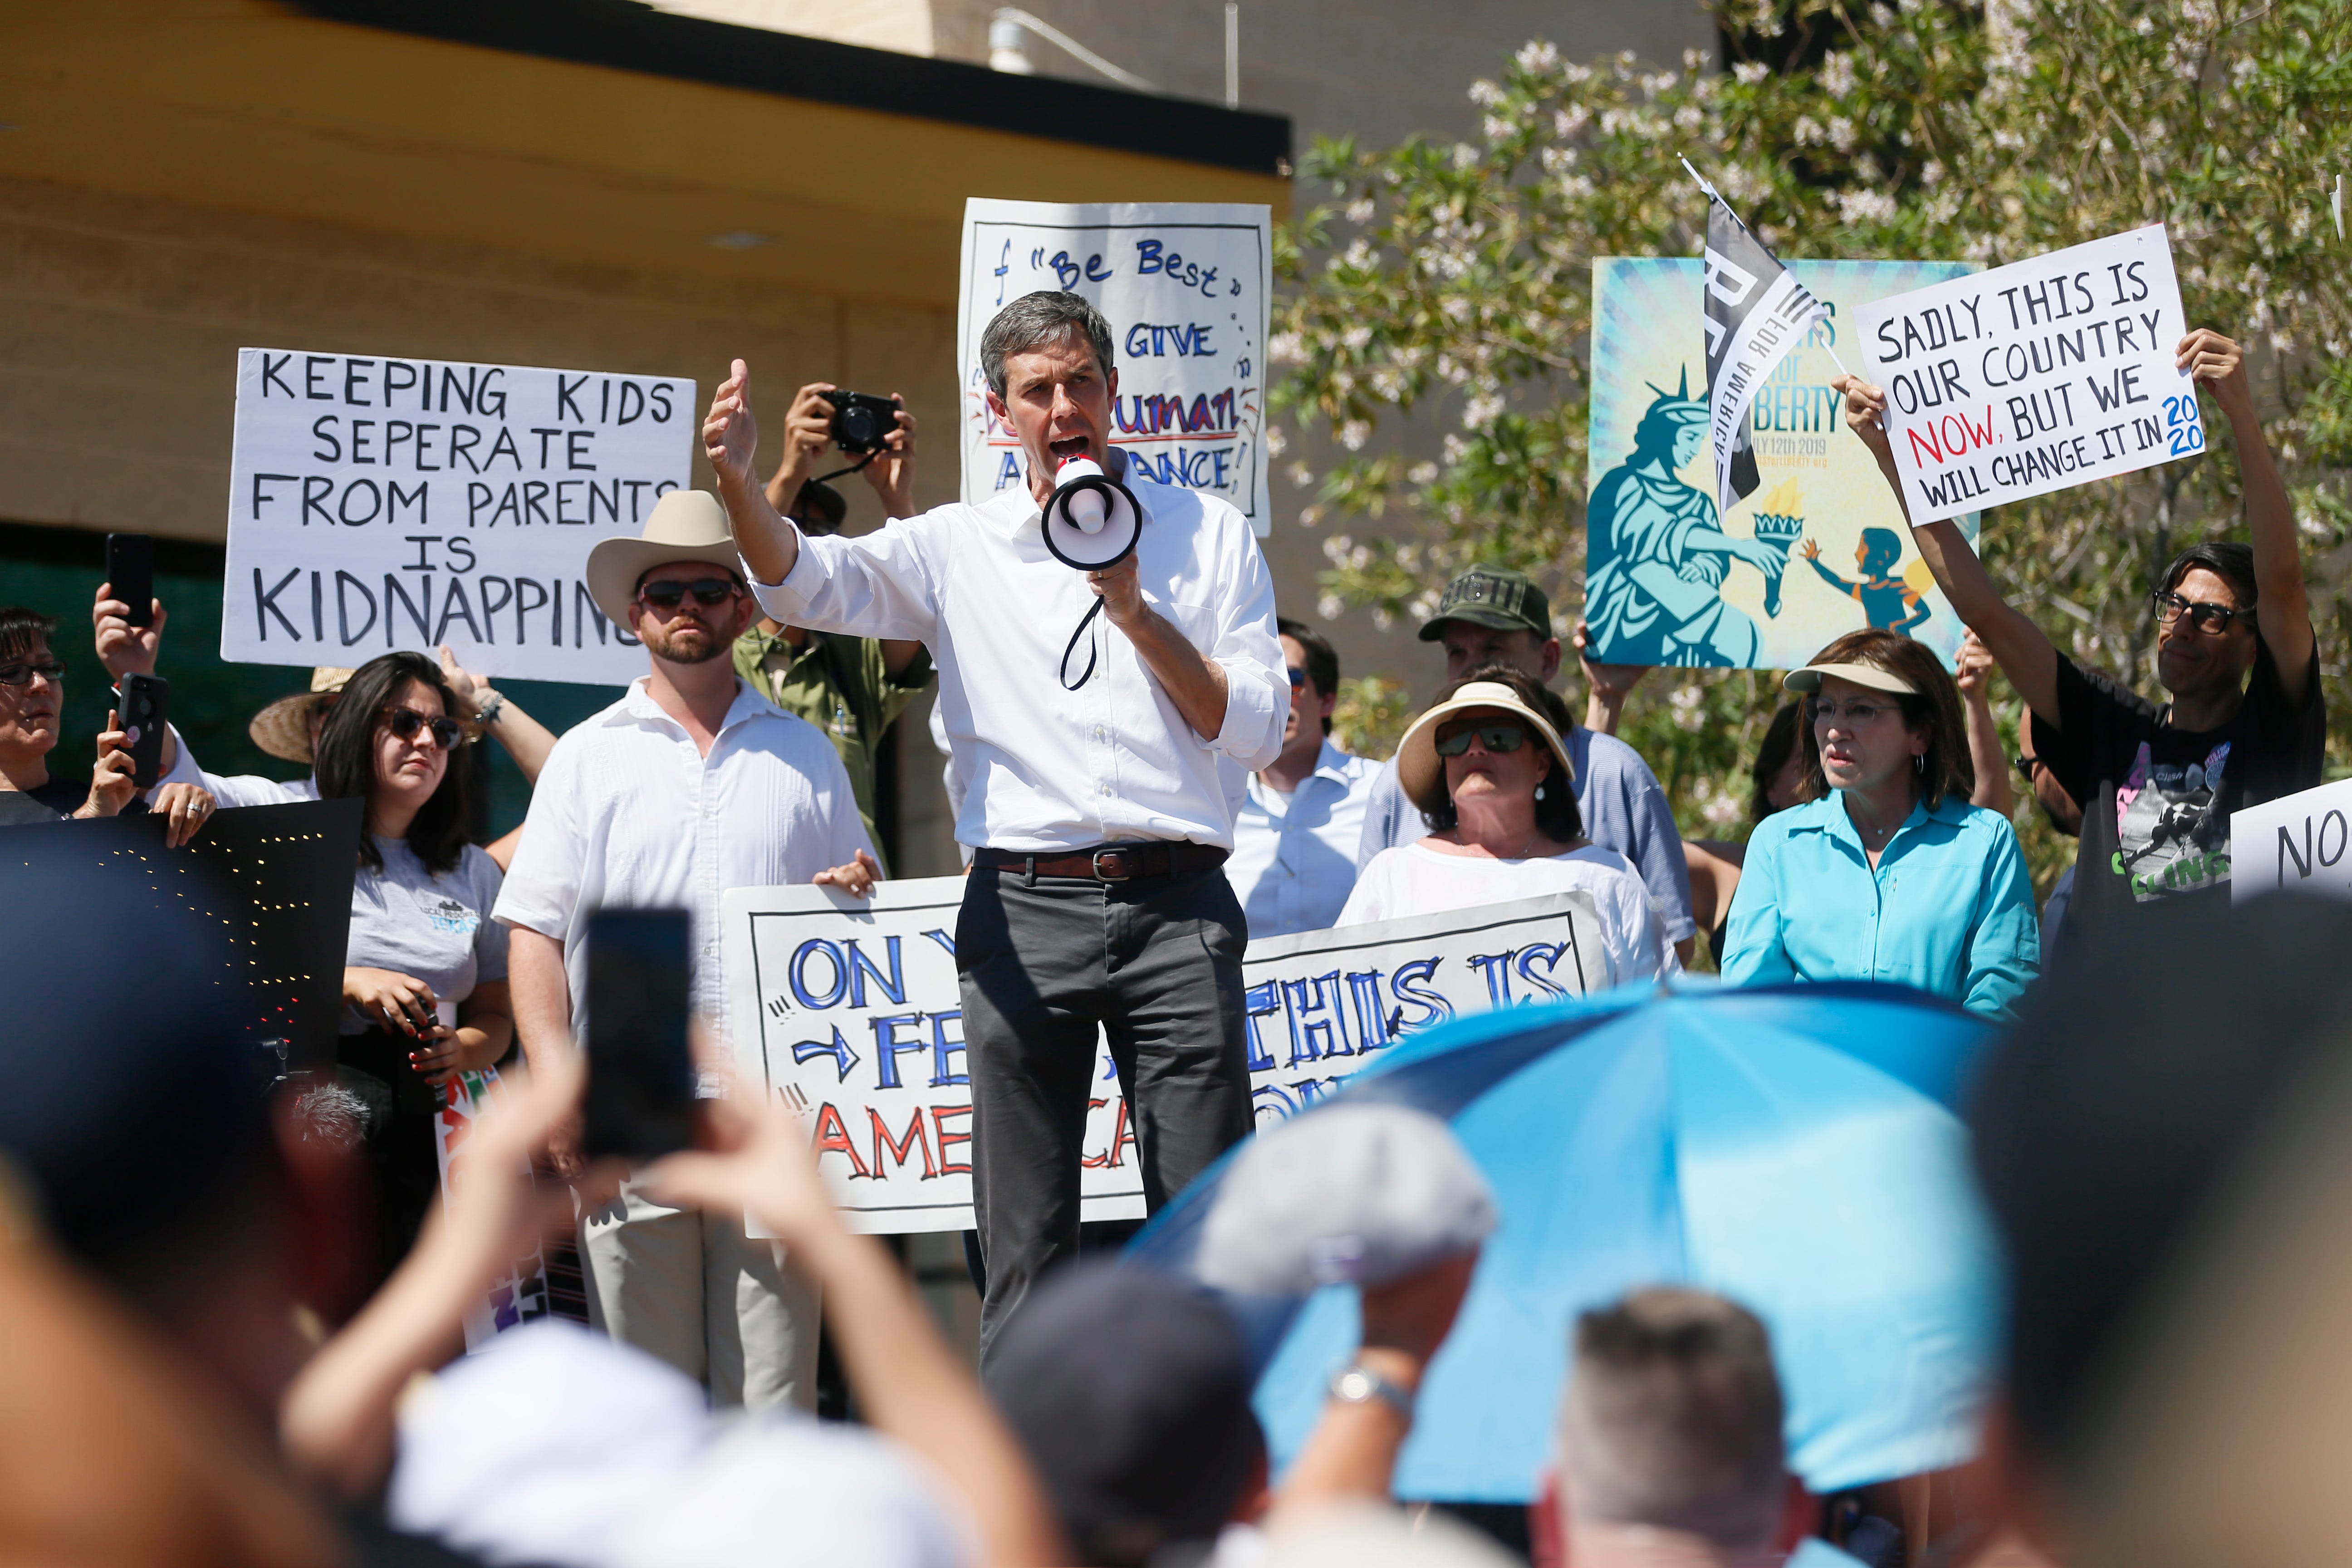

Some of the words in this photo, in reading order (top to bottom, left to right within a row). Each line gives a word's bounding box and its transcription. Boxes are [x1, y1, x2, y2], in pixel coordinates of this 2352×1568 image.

[1126, 322, 1218, 358] GIVE
[1878, 294, 1993, 363] SADLY,
[1998, 272, 2094, 330] THIS
[2107, 261, 2148, 307] IS
[262, 353, 507, 419] KEEPING
[558, 374, 674, 425] KIDS
[1892, 358, 1970, 415] OUR
[1983, 309, 2161, 387] COUNTRY
[1754, 385, 1841, 433] BERTY
[1906, 404, 2004, 470] NOW,
[2005, 382, 2075, 442] BUT
[2087, 364, 2149, 412] WE
[2161, 394, 2199, 427] 20
[313, 415, 596, 475] SEPERATE
[1771, 436, 1796, 455] 12th
[1798, 437, 1827, 456] 2019
[1919, 466, 1990, 508] WILL
[1992, 436, 2096, 487] CHANGE
[2096, 424, 2126, 461] IT
[2132, 414, 2163, 449] IN
[2166, 425, 2204, 456] 20
[253, 473, 429, 526] FROM
[402, 535, 476, 573] IS
[789, 935, 912, 1010] ON
[1245, 956, 1456, 1072] THIS
[1465, 941, 1574, 1011] IS
